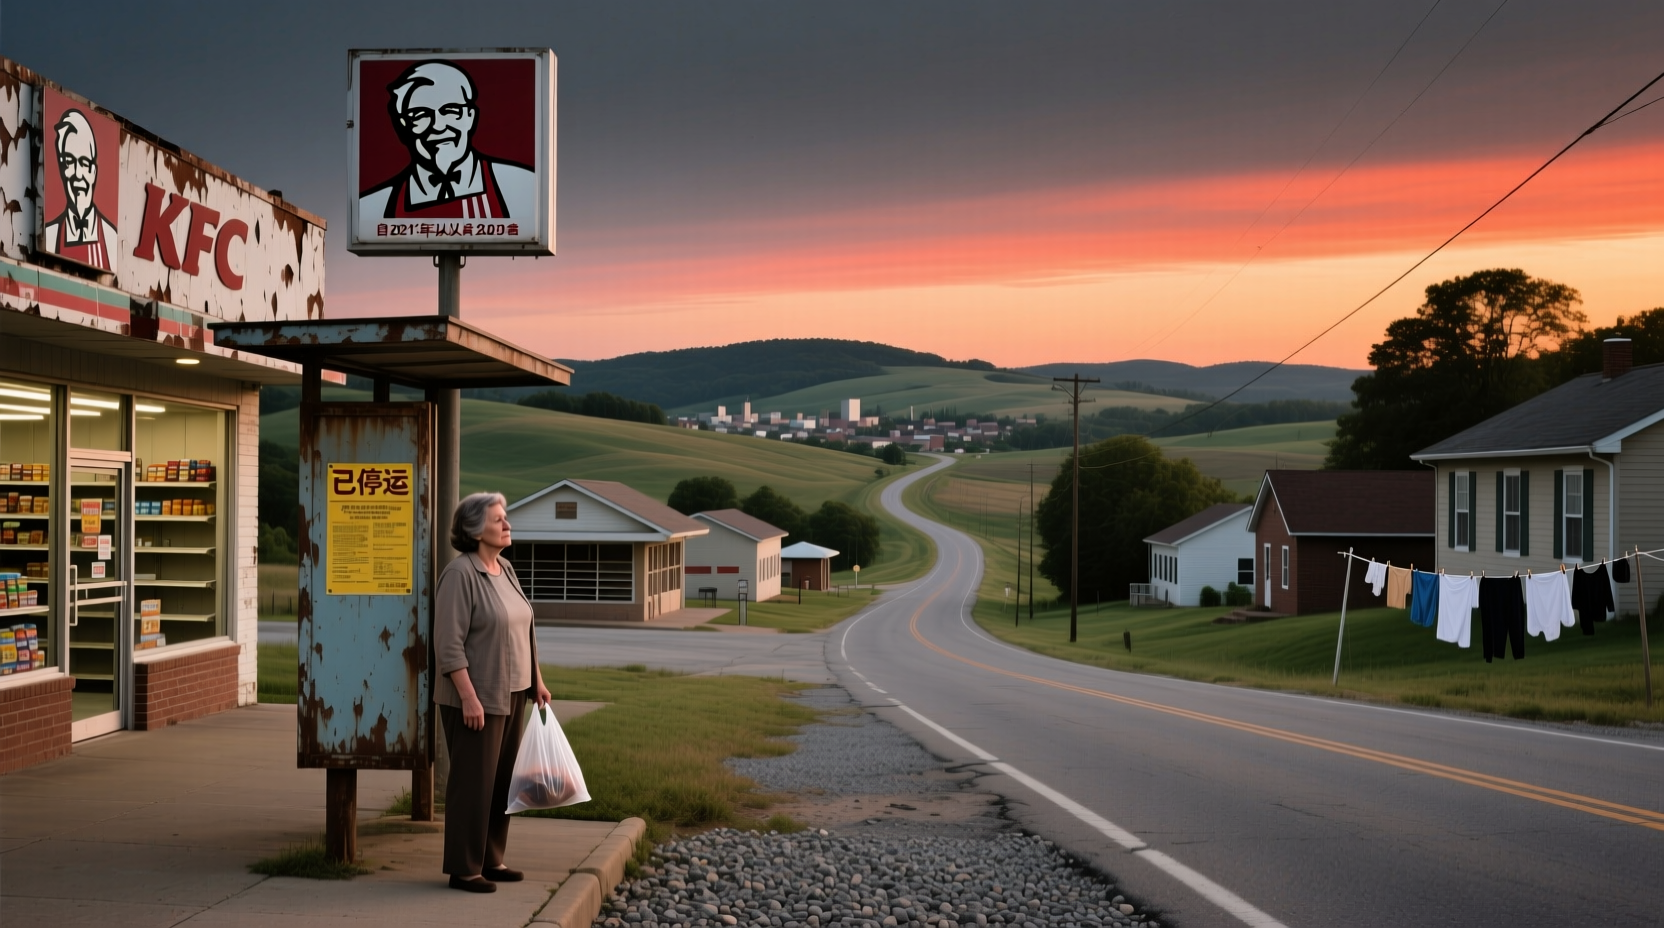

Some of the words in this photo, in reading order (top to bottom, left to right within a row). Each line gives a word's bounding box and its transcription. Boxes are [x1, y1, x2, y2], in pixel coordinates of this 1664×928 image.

[133, 183, 248, 290] KFC
[332, 468, 409, 496] 已停运
